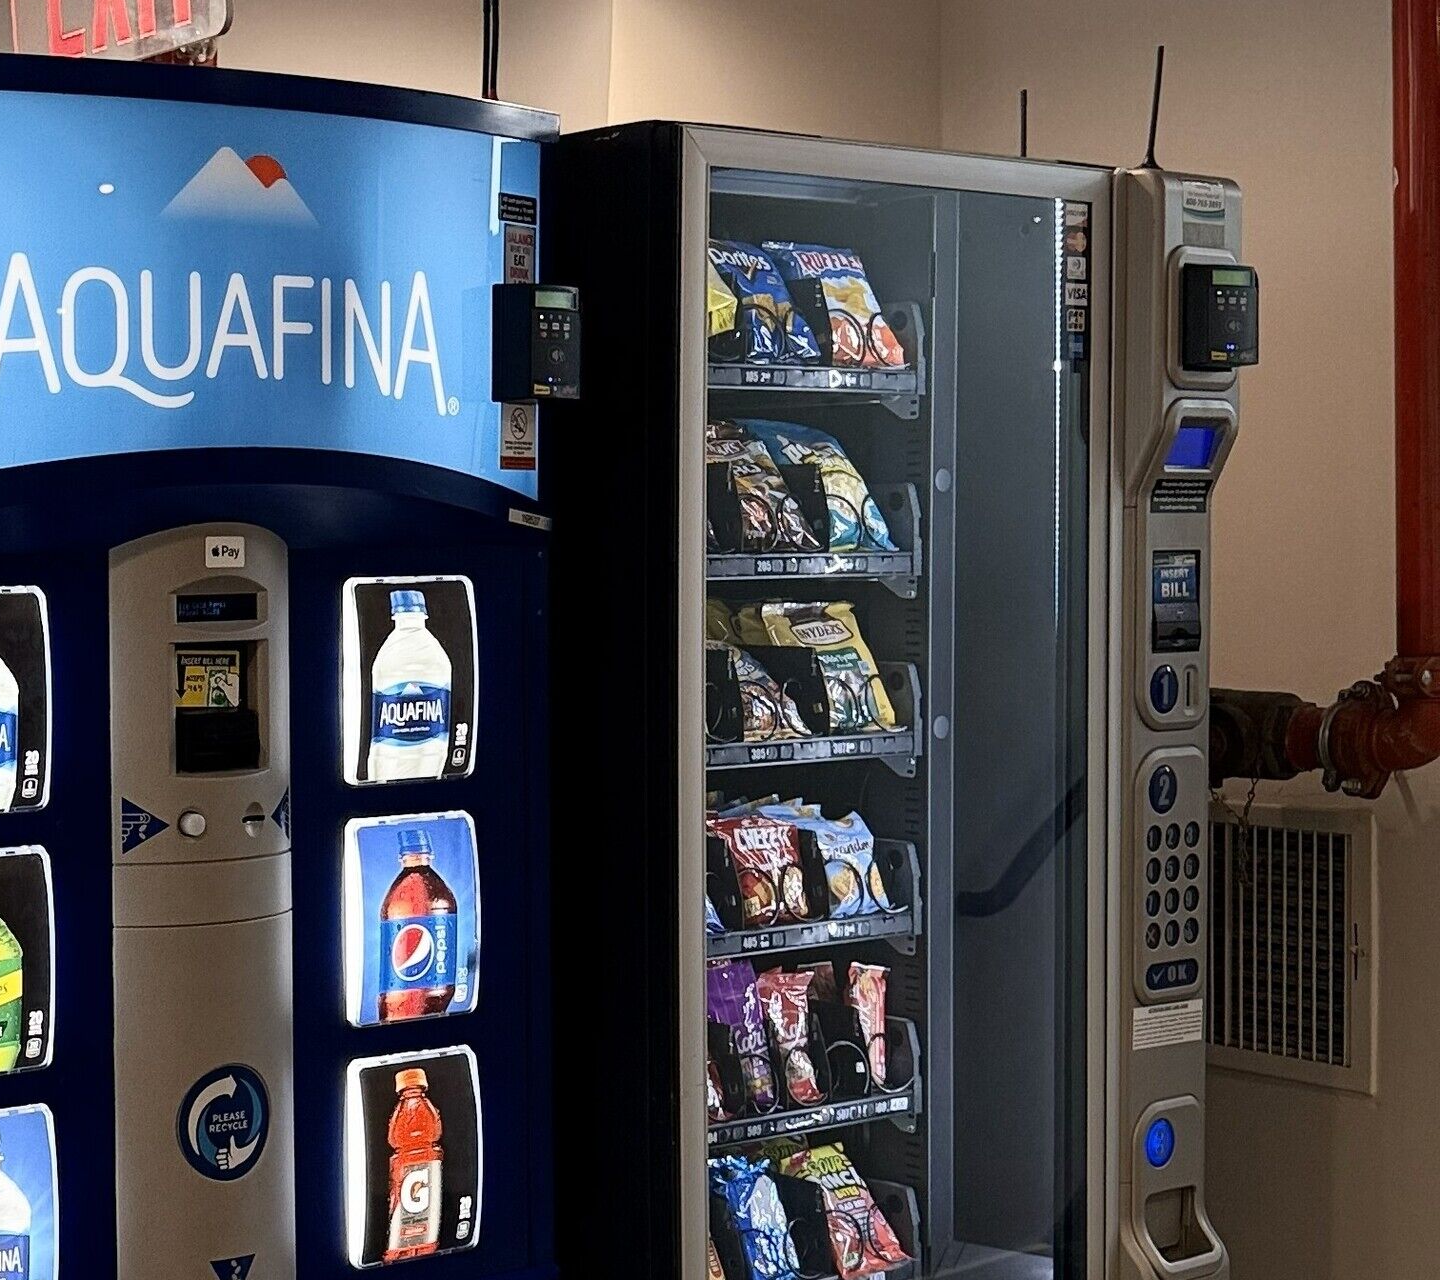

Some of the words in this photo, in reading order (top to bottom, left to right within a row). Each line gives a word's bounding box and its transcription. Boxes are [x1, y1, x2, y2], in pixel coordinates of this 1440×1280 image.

[513, 254, 526, 266] EAT
[708, 247, 772, 271] Doritos
[1067, 288, 1087, 300] VISA
[221, 545, 240, 560] Pay
[1160, 568, 1189, 579] INSERT
[1161, 581, 1190, 598] BILL
[1160, 675, 1169, 705] 1
[380, 699, 445, 728] AQUAFINA
[25, 750, 40, 765] 20
[1158, 774, 1171, 807] 2
[435, 924, 447, 974] pepsi
[1166, 963, 1188, 982] OK
[212, 1110, 246, 1123] PLEASE
[209, 1119, 248, 1133] RECYCLE
[807, 1154, 845, 1177] SOUR
[401, 1168, 430, 1215] G
